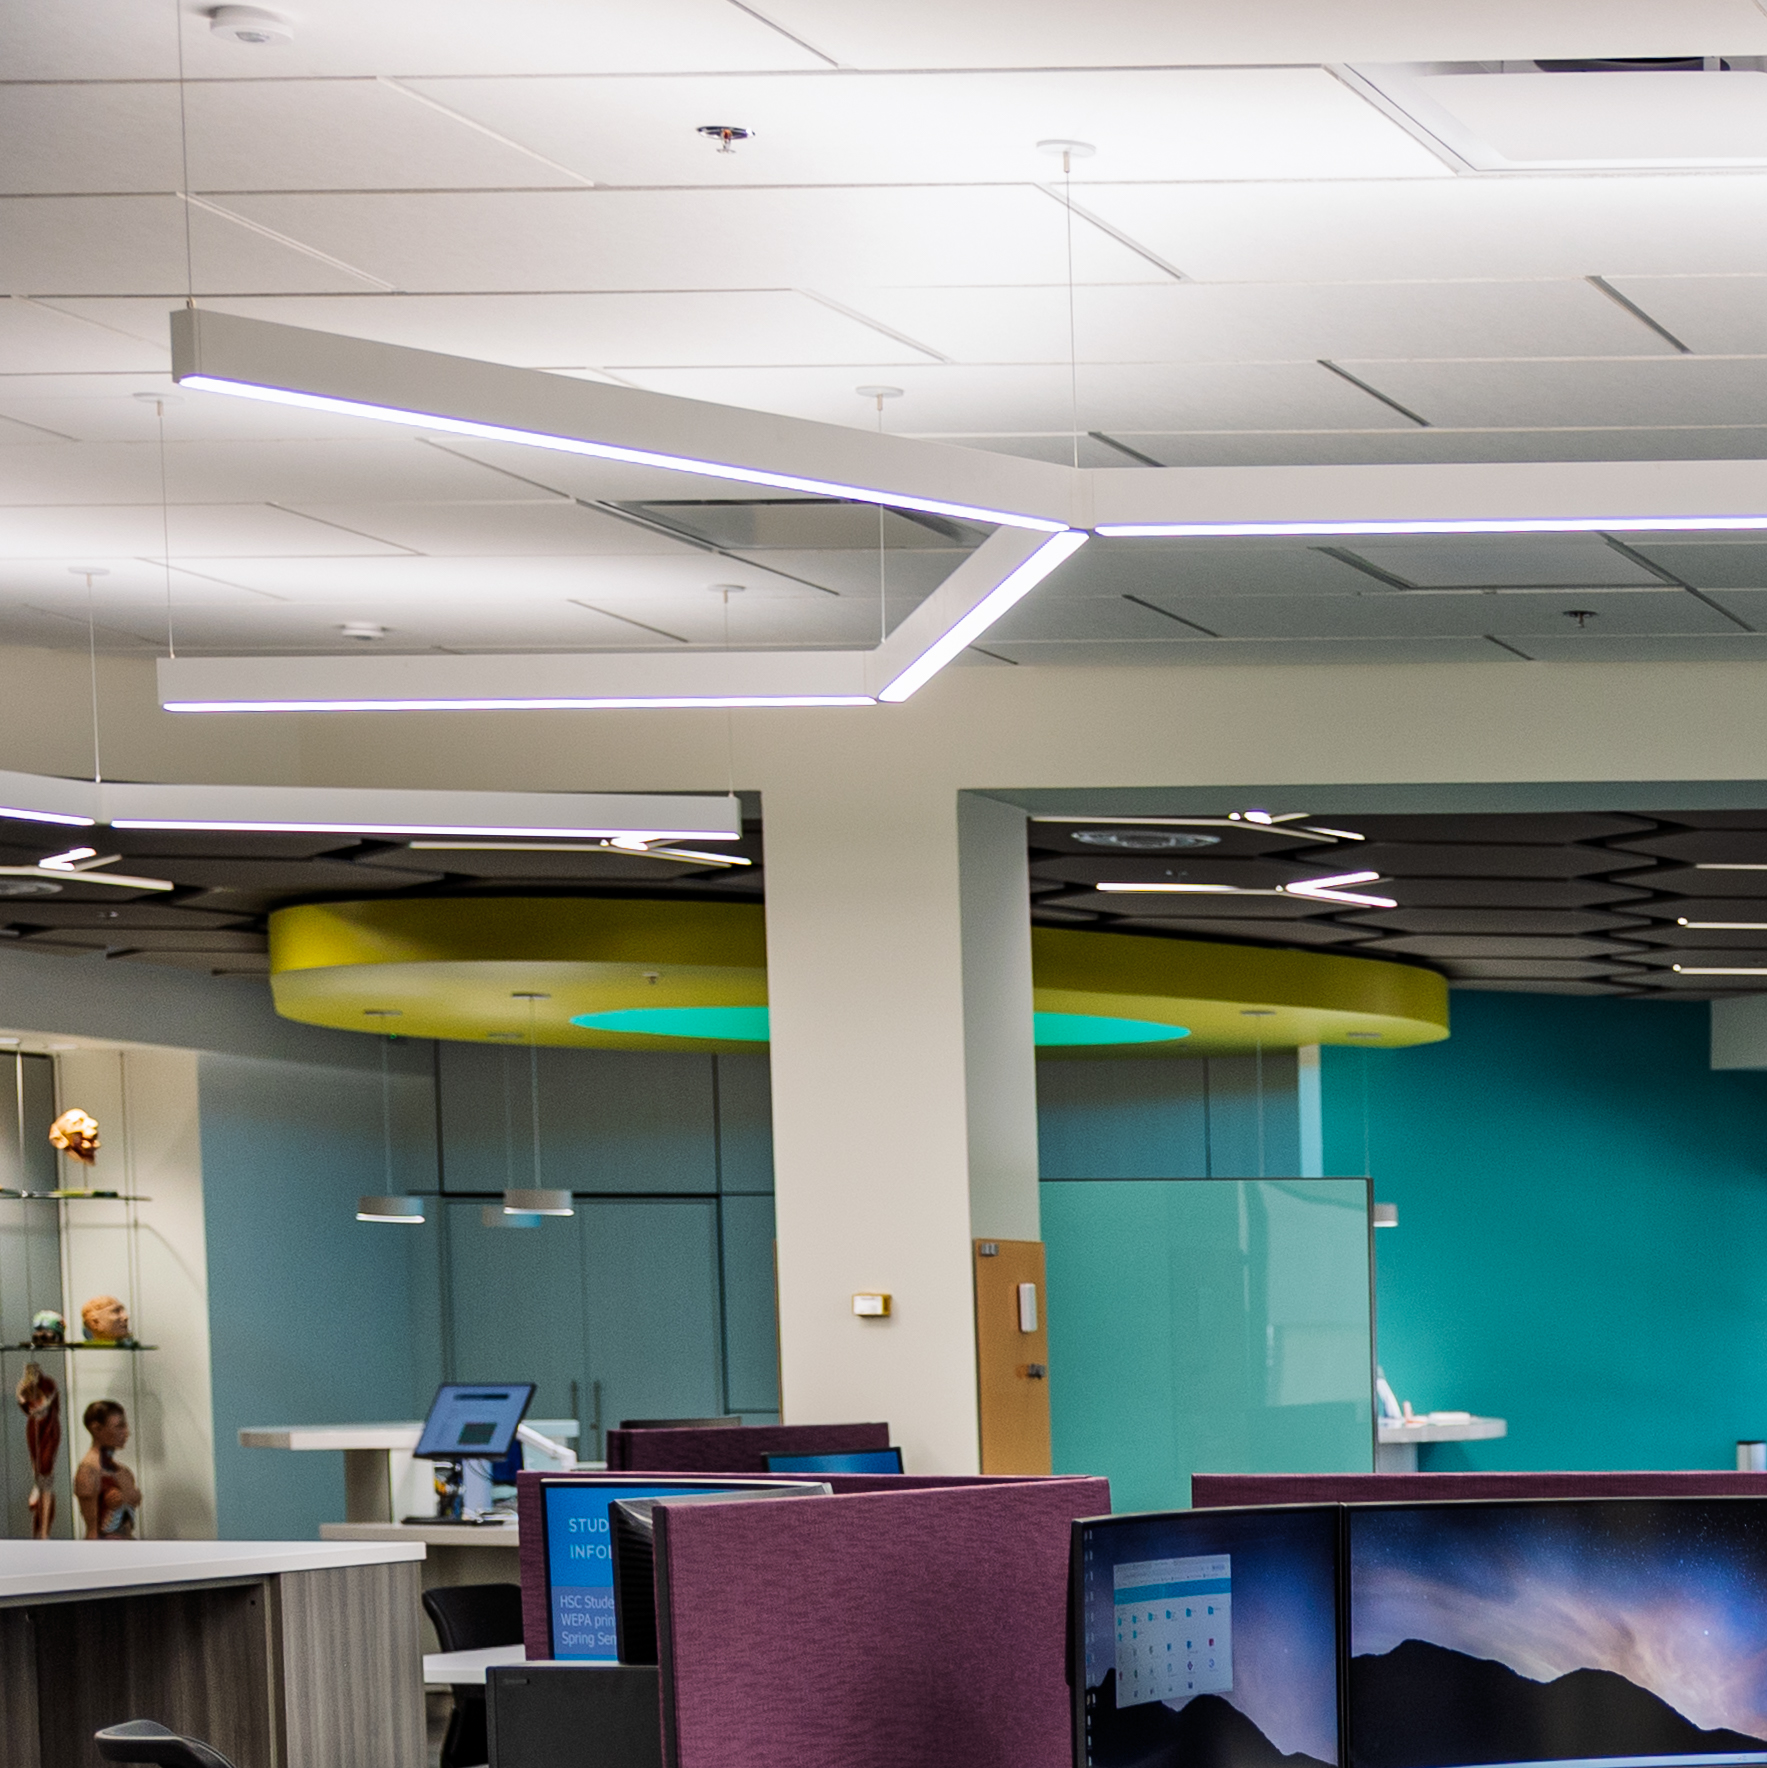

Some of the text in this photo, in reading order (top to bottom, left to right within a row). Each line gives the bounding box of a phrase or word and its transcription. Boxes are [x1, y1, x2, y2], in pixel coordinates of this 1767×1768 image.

[570, 1544, 612, 1559] INFO
[560, 1595, 582, 1609] HSC
[561, 1614, 592, 1627] WEPA
[562, 1631, 594, 1647] Spring
